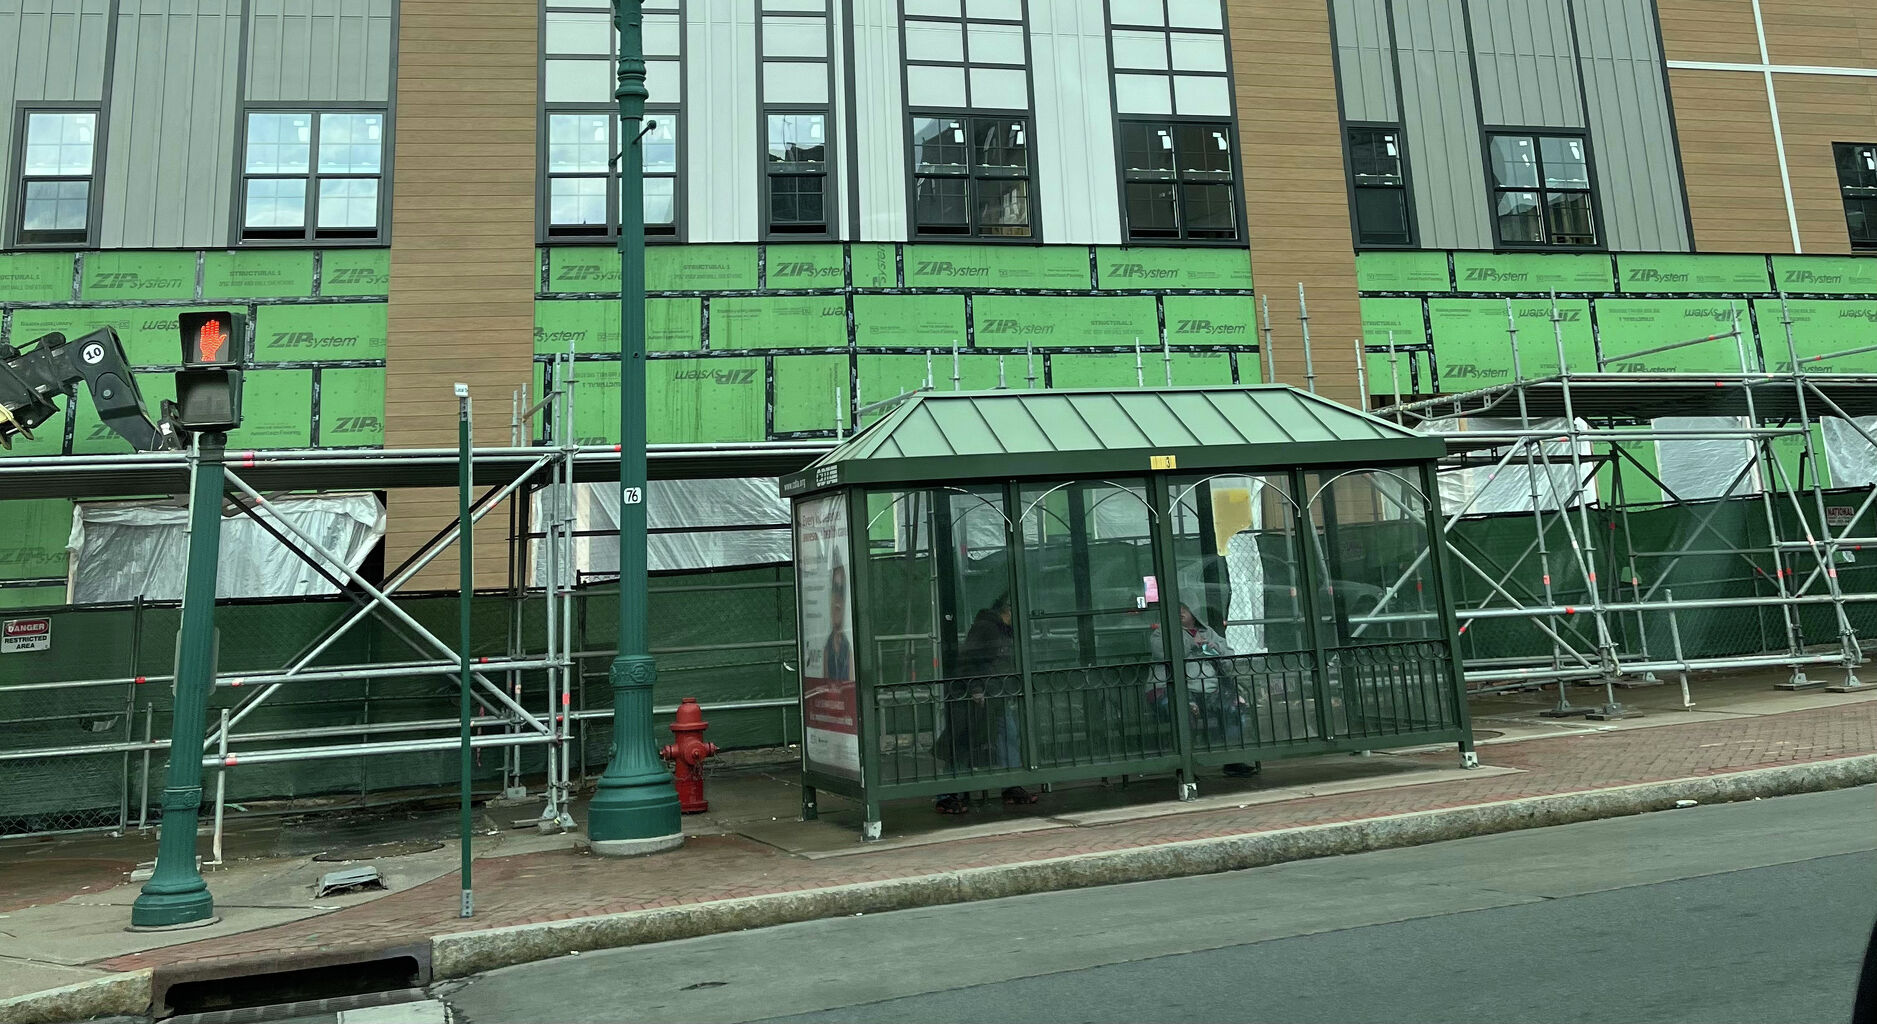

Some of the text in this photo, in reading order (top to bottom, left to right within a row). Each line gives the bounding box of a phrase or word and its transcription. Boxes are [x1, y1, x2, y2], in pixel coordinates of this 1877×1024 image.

[328, 268, 388, 284] ZIPsys
[533, 327, 588, 342] Psystem
[86, 346, 102, 361] 10
[330, 416, 383, 433] ZIPsy
[626, 490, 638, 502] 76
[8, 624, 44, 632] DANGER
[4, 636, 47, 644] RESTRICTED
